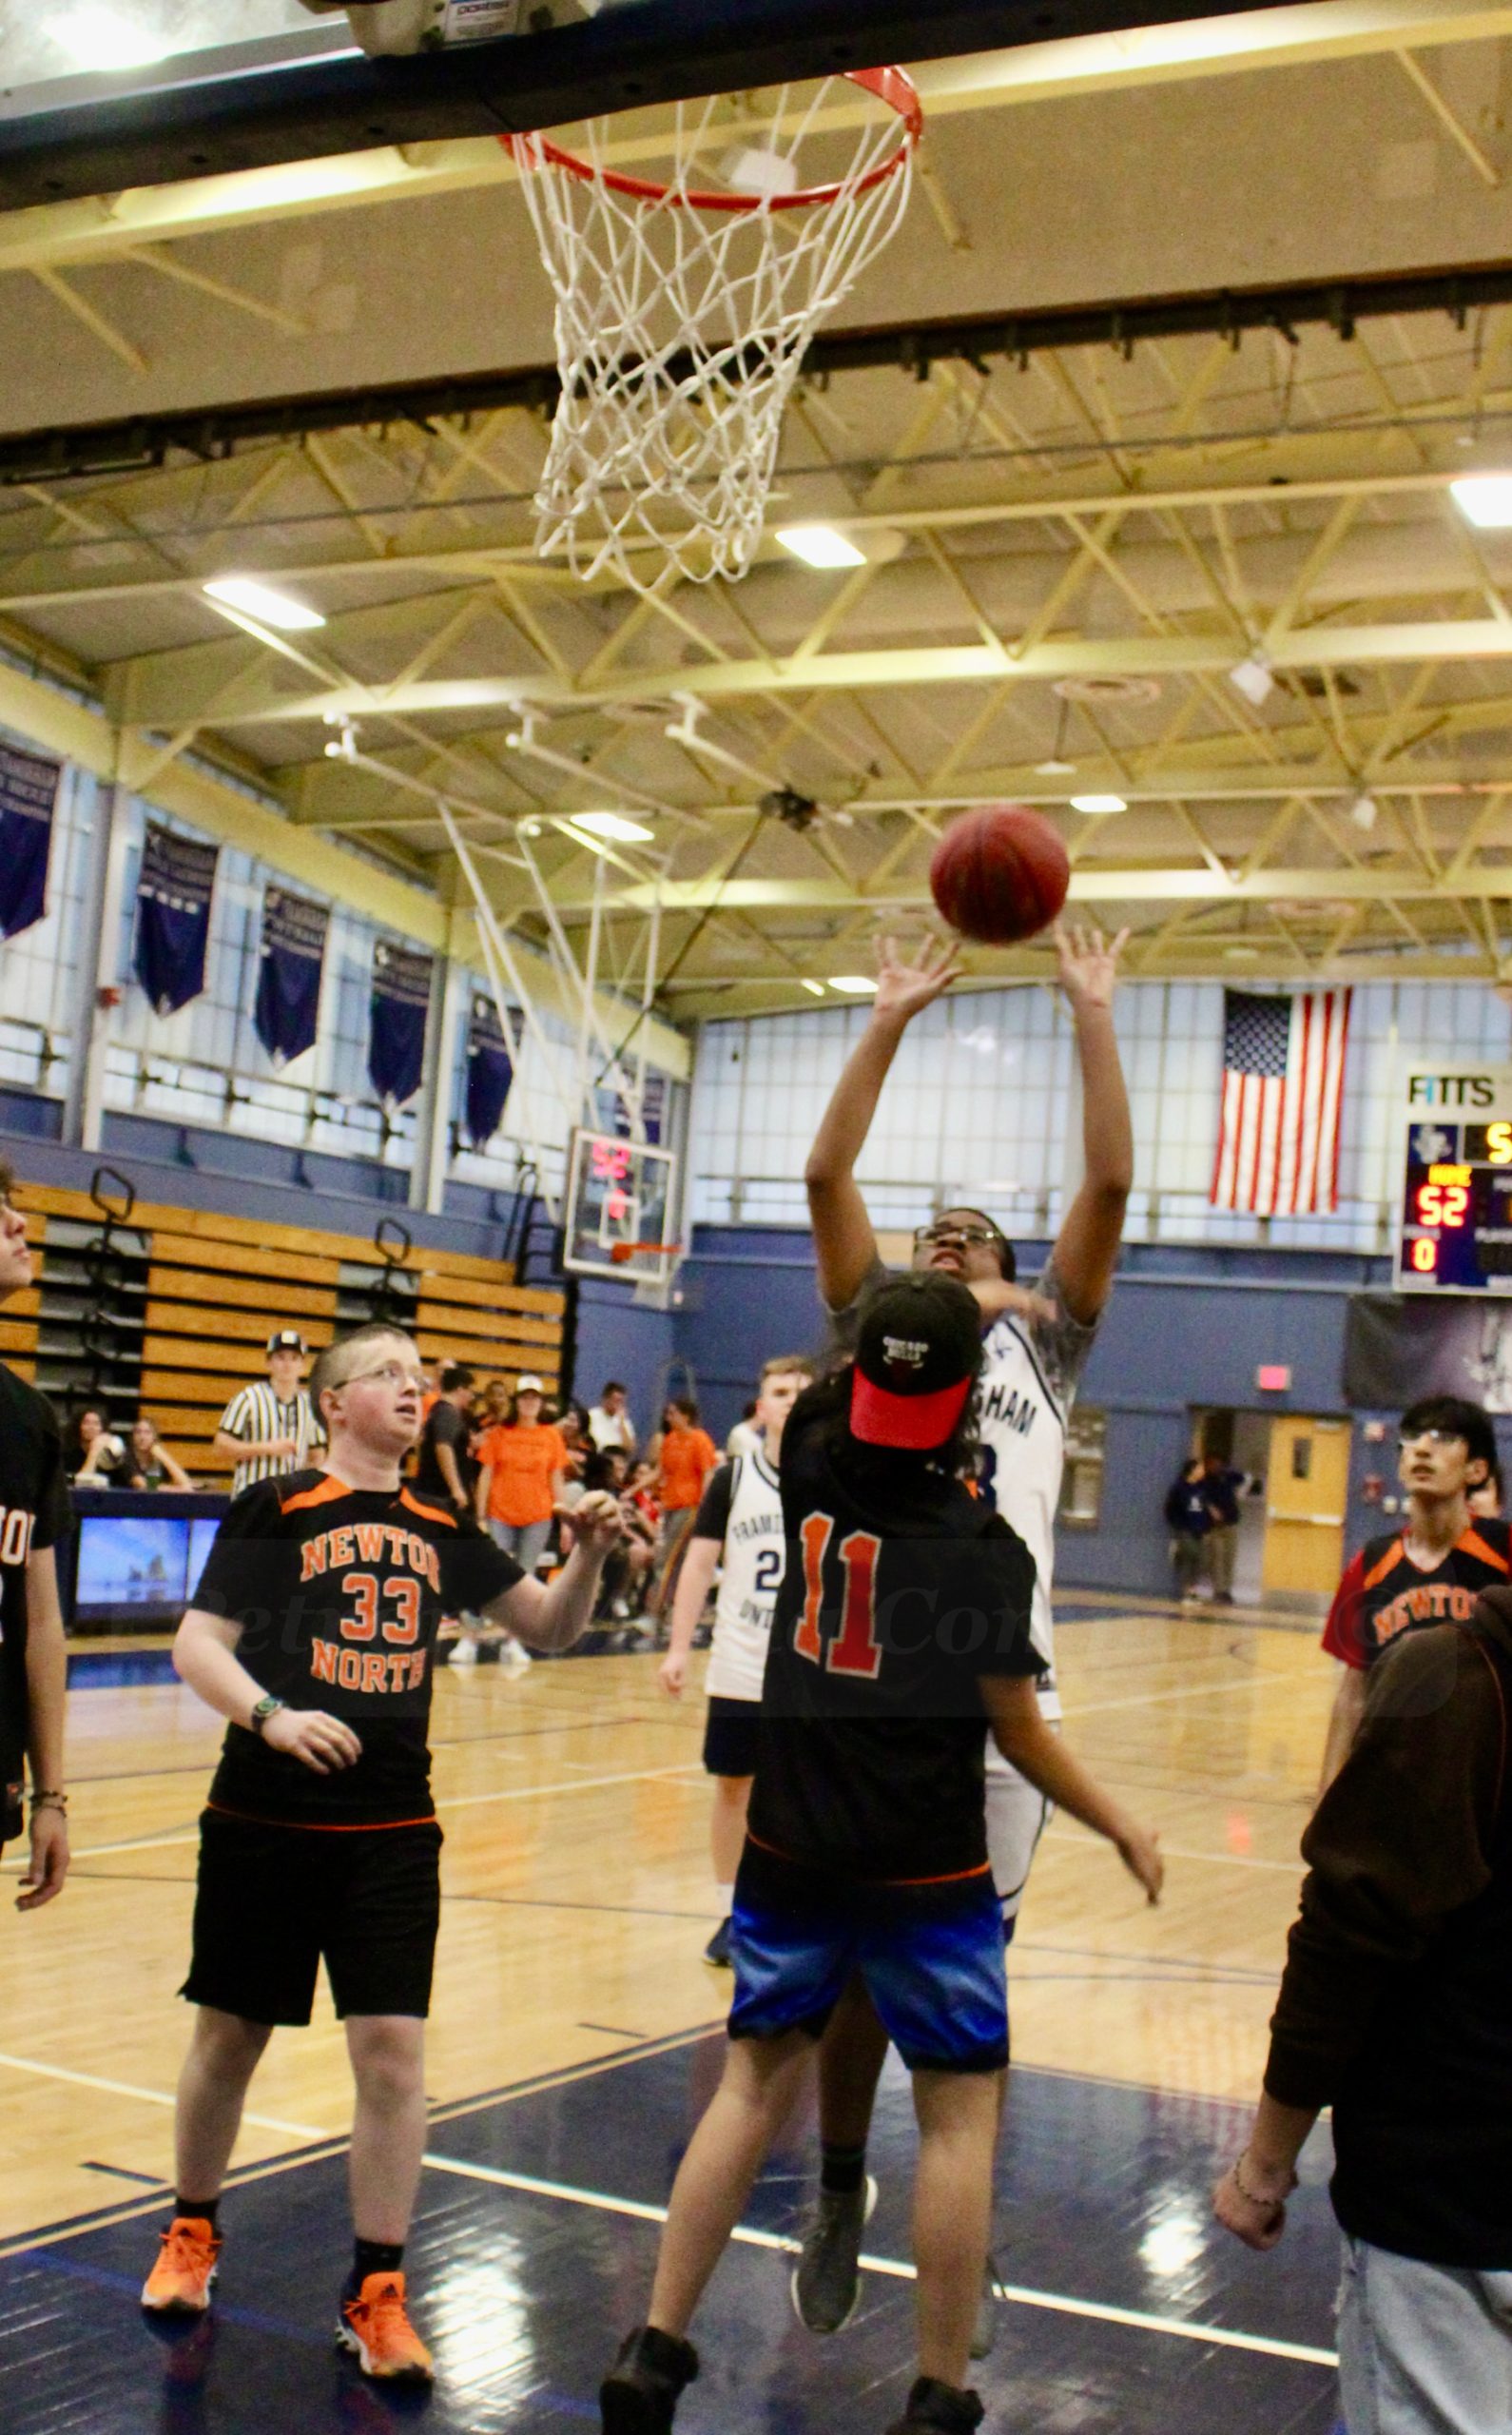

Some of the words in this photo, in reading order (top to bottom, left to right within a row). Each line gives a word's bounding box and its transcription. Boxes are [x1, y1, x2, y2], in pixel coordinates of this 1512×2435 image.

[1409, 1075, 1495, 1107] FITTS
[1417, 1185, 1469, 1228] 52
[339, 1571, 421, 1645] 33
[793, 1510, 882, 1681] 11
[1372, 1582, 1478, 1646] NEWTO
